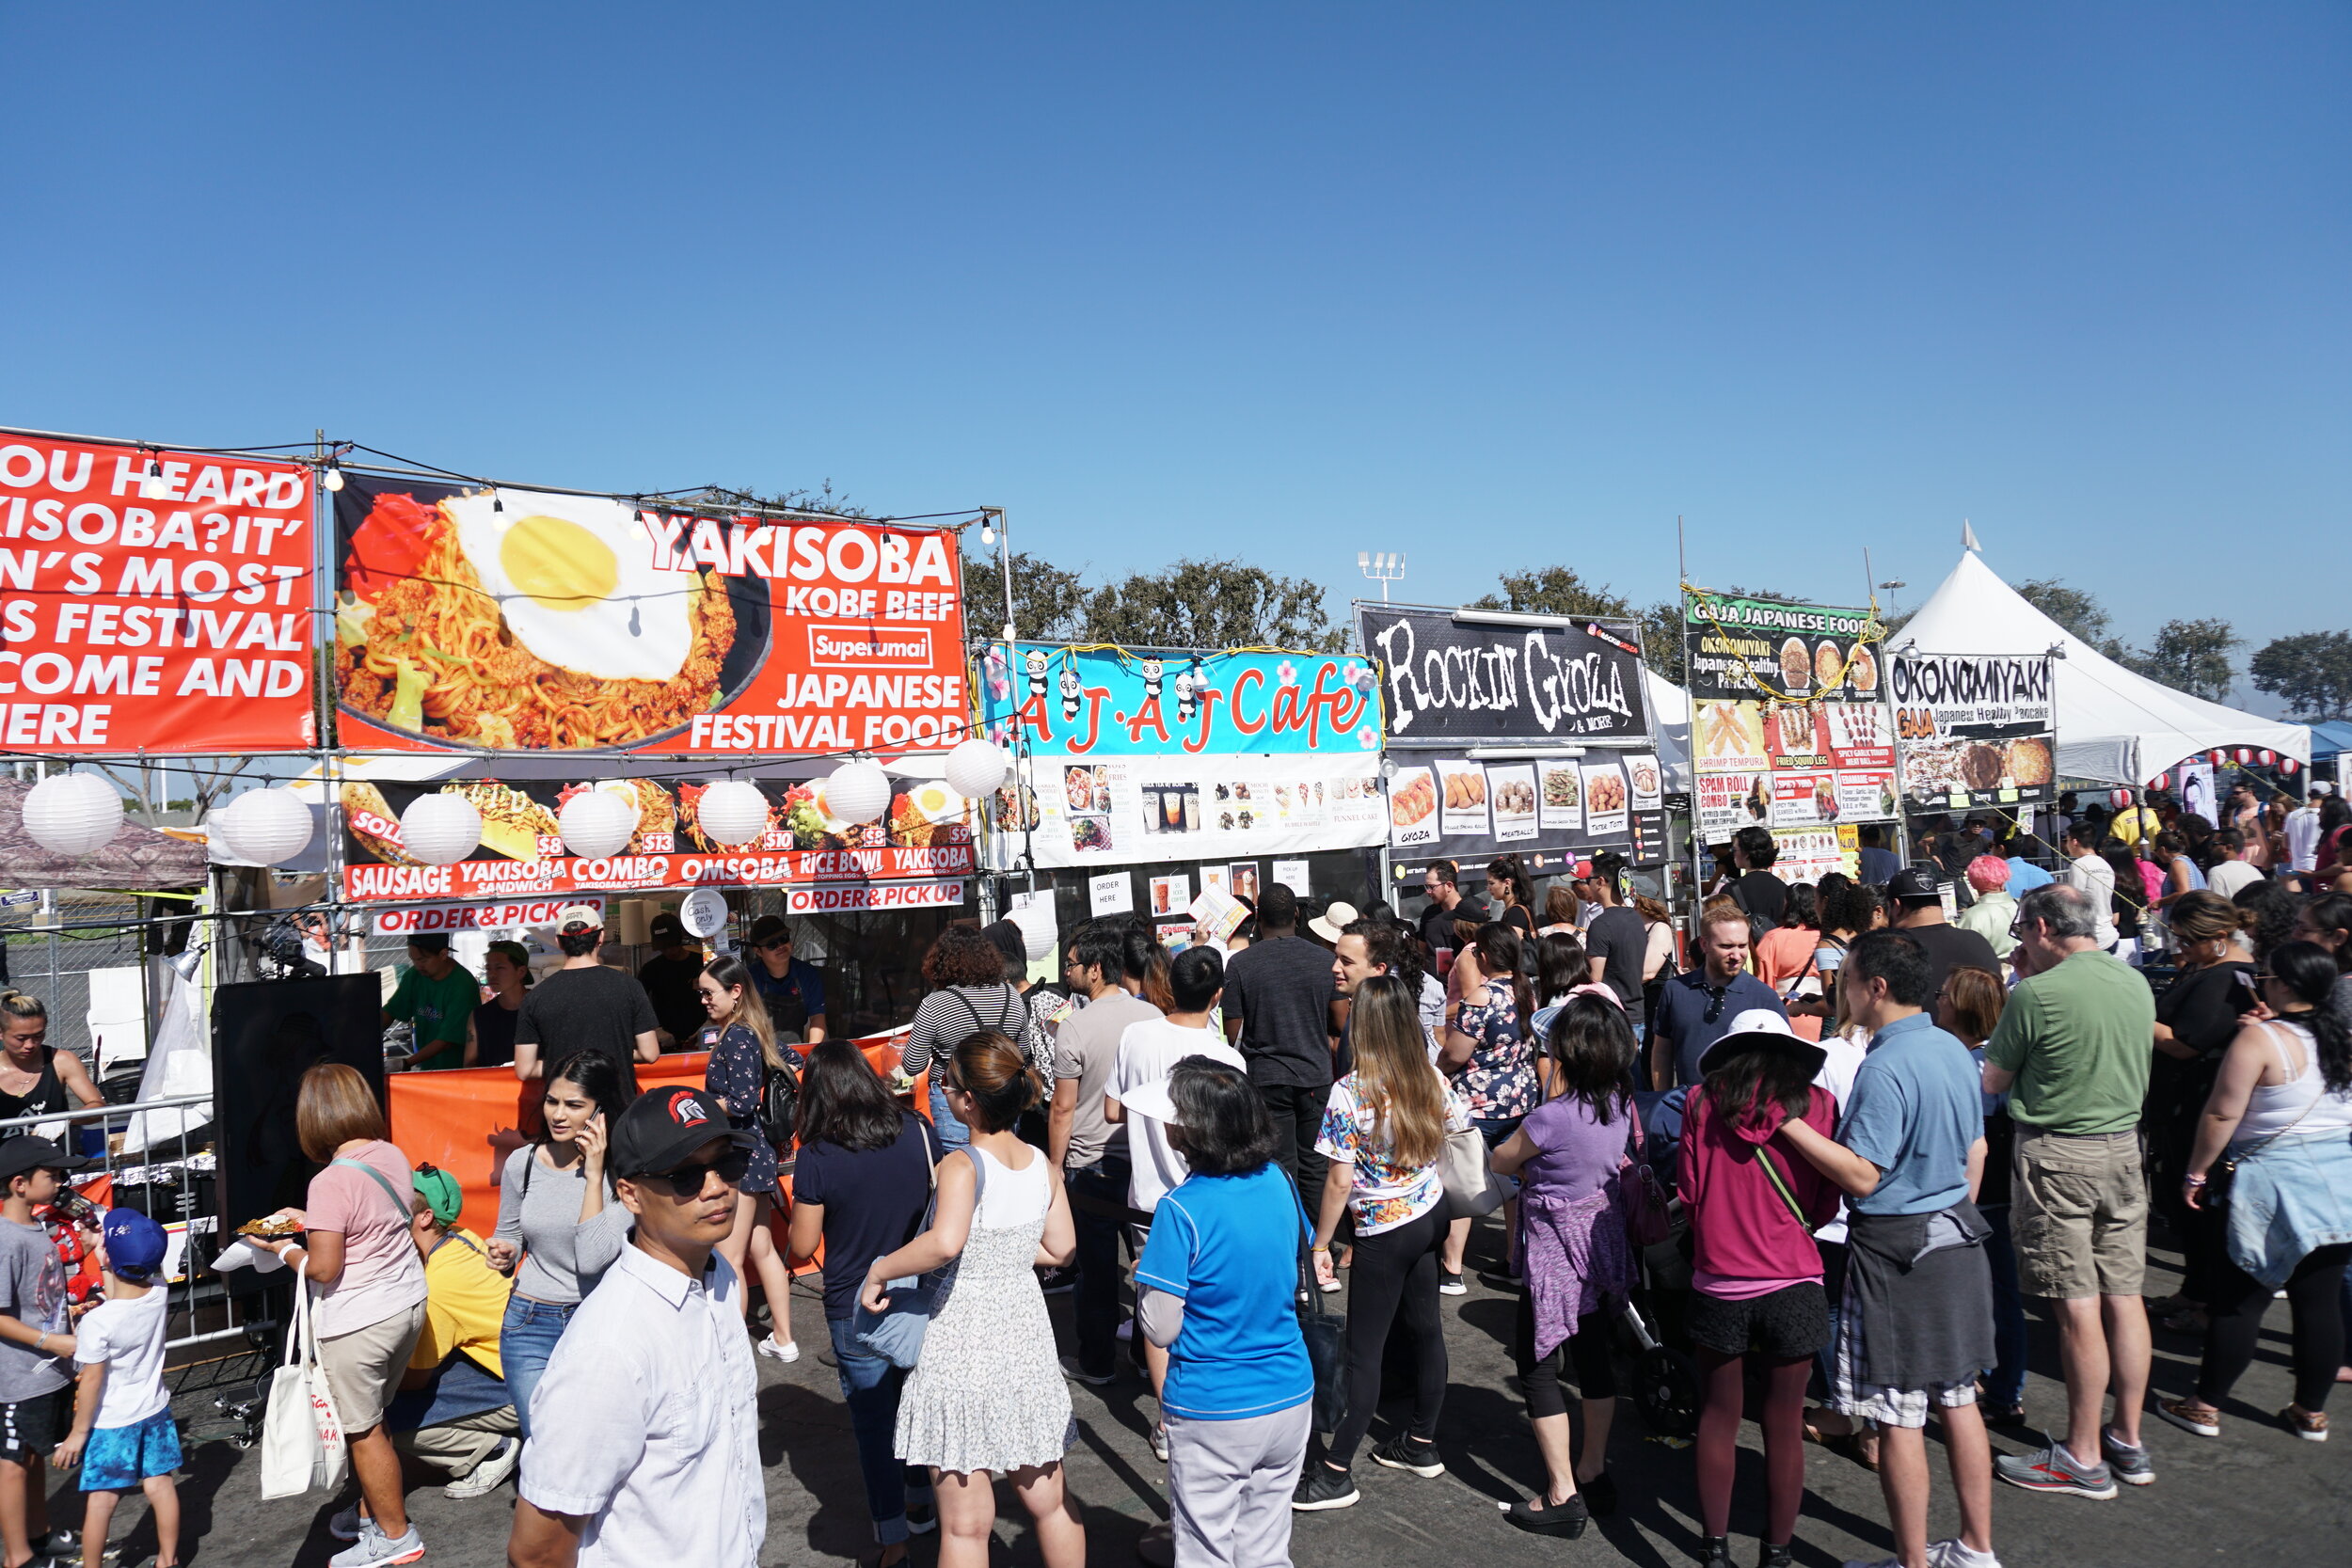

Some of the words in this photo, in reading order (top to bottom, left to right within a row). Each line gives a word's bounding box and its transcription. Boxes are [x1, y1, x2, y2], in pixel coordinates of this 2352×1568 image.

[111, 455, 304, 510] HEARD
[0, 496, 303, 557] ISOBA?IT'
[642, 512, 954, 586] YAKISOBA
[116, 556, 303, 606] MOST
[786, 586, 877, 618] KOBE
[885, 590, 956, 621] BEEF
[55, 603, 302, 651] FESTIVAL
[1693, 603, 1739, 623] GAJA
[1742, 608, 1826, 630] JAPANESE
[816, 634, 926, 660] Superumai
[1701, 637, 1771, 657] OKONOMIYAKI
[176, 657, 304, 698] AND
[1375, 618, 1518, 735] ROCKIN
[1524, 628, 1632, 733] GYOZA
[1893, 657, 2049, 705] OKONOMIYAKI
[777, 673, 961, 709] JAPANESE
[1231, 661, 1369, 749] Cafe
[0, 703, 111, 745] ERE
[691, 715, 854, 749] FESTIVAL
[864, 716, 963, 749] FOOD
[1586, 715, 1613, 732] MORE
[1897, 706, 1937, 740] GAJA
[1977, 707, 2012, 722] Healthy
[1699, 757, 1727, 768] SHRIMP
[1729, 757, 1765, 768] TEMPURA
[1776, 755, 1794, 767] FRIED
[1794, 755, 1814, 766] SQUID
[1815, 755, 1828, 765] LEG
[1699, 777, 1724, 794] SPAM
[1726, 776, 1749, 792] ROLL
[1701, 794, 1727, 808] COMBO
[1334, 815, 1359, 823] FUNNEL
[1362, 813, 1378, 821] CAKE
[644, 833, 673, 852] $13
[765, 832, 792, 848] $10
[866, 830, 884, 846] $8
[951, 828, 969, 843] $9
[1401, 830, 1430, 843] GYOZA
[1501, 828, 1535, 839] MEATBALLS
[1839, 828, 1856, 836] Special
[538, 835, 562, 854] $8
[572, 856, 670, 881] COMBO
[681, 856, 792, 882] OMSOBA
[800, 851, 837, 875] RICE
[839, 849, 883, 873] BOWL
[893, 847, 968, 871] YAKISOBA
[352, 864, 452, 897] SAUSAGE
[460, 860, 567, 882] YAKISOBA
[477, 879, 552, 894] SANDWICH
[933, 885, 961, 902] UP
[1096, 880, 1120, 891] ORDER
[688, 904, 710, 917] Cash
[1099, 894, 1117, 904] HERE
